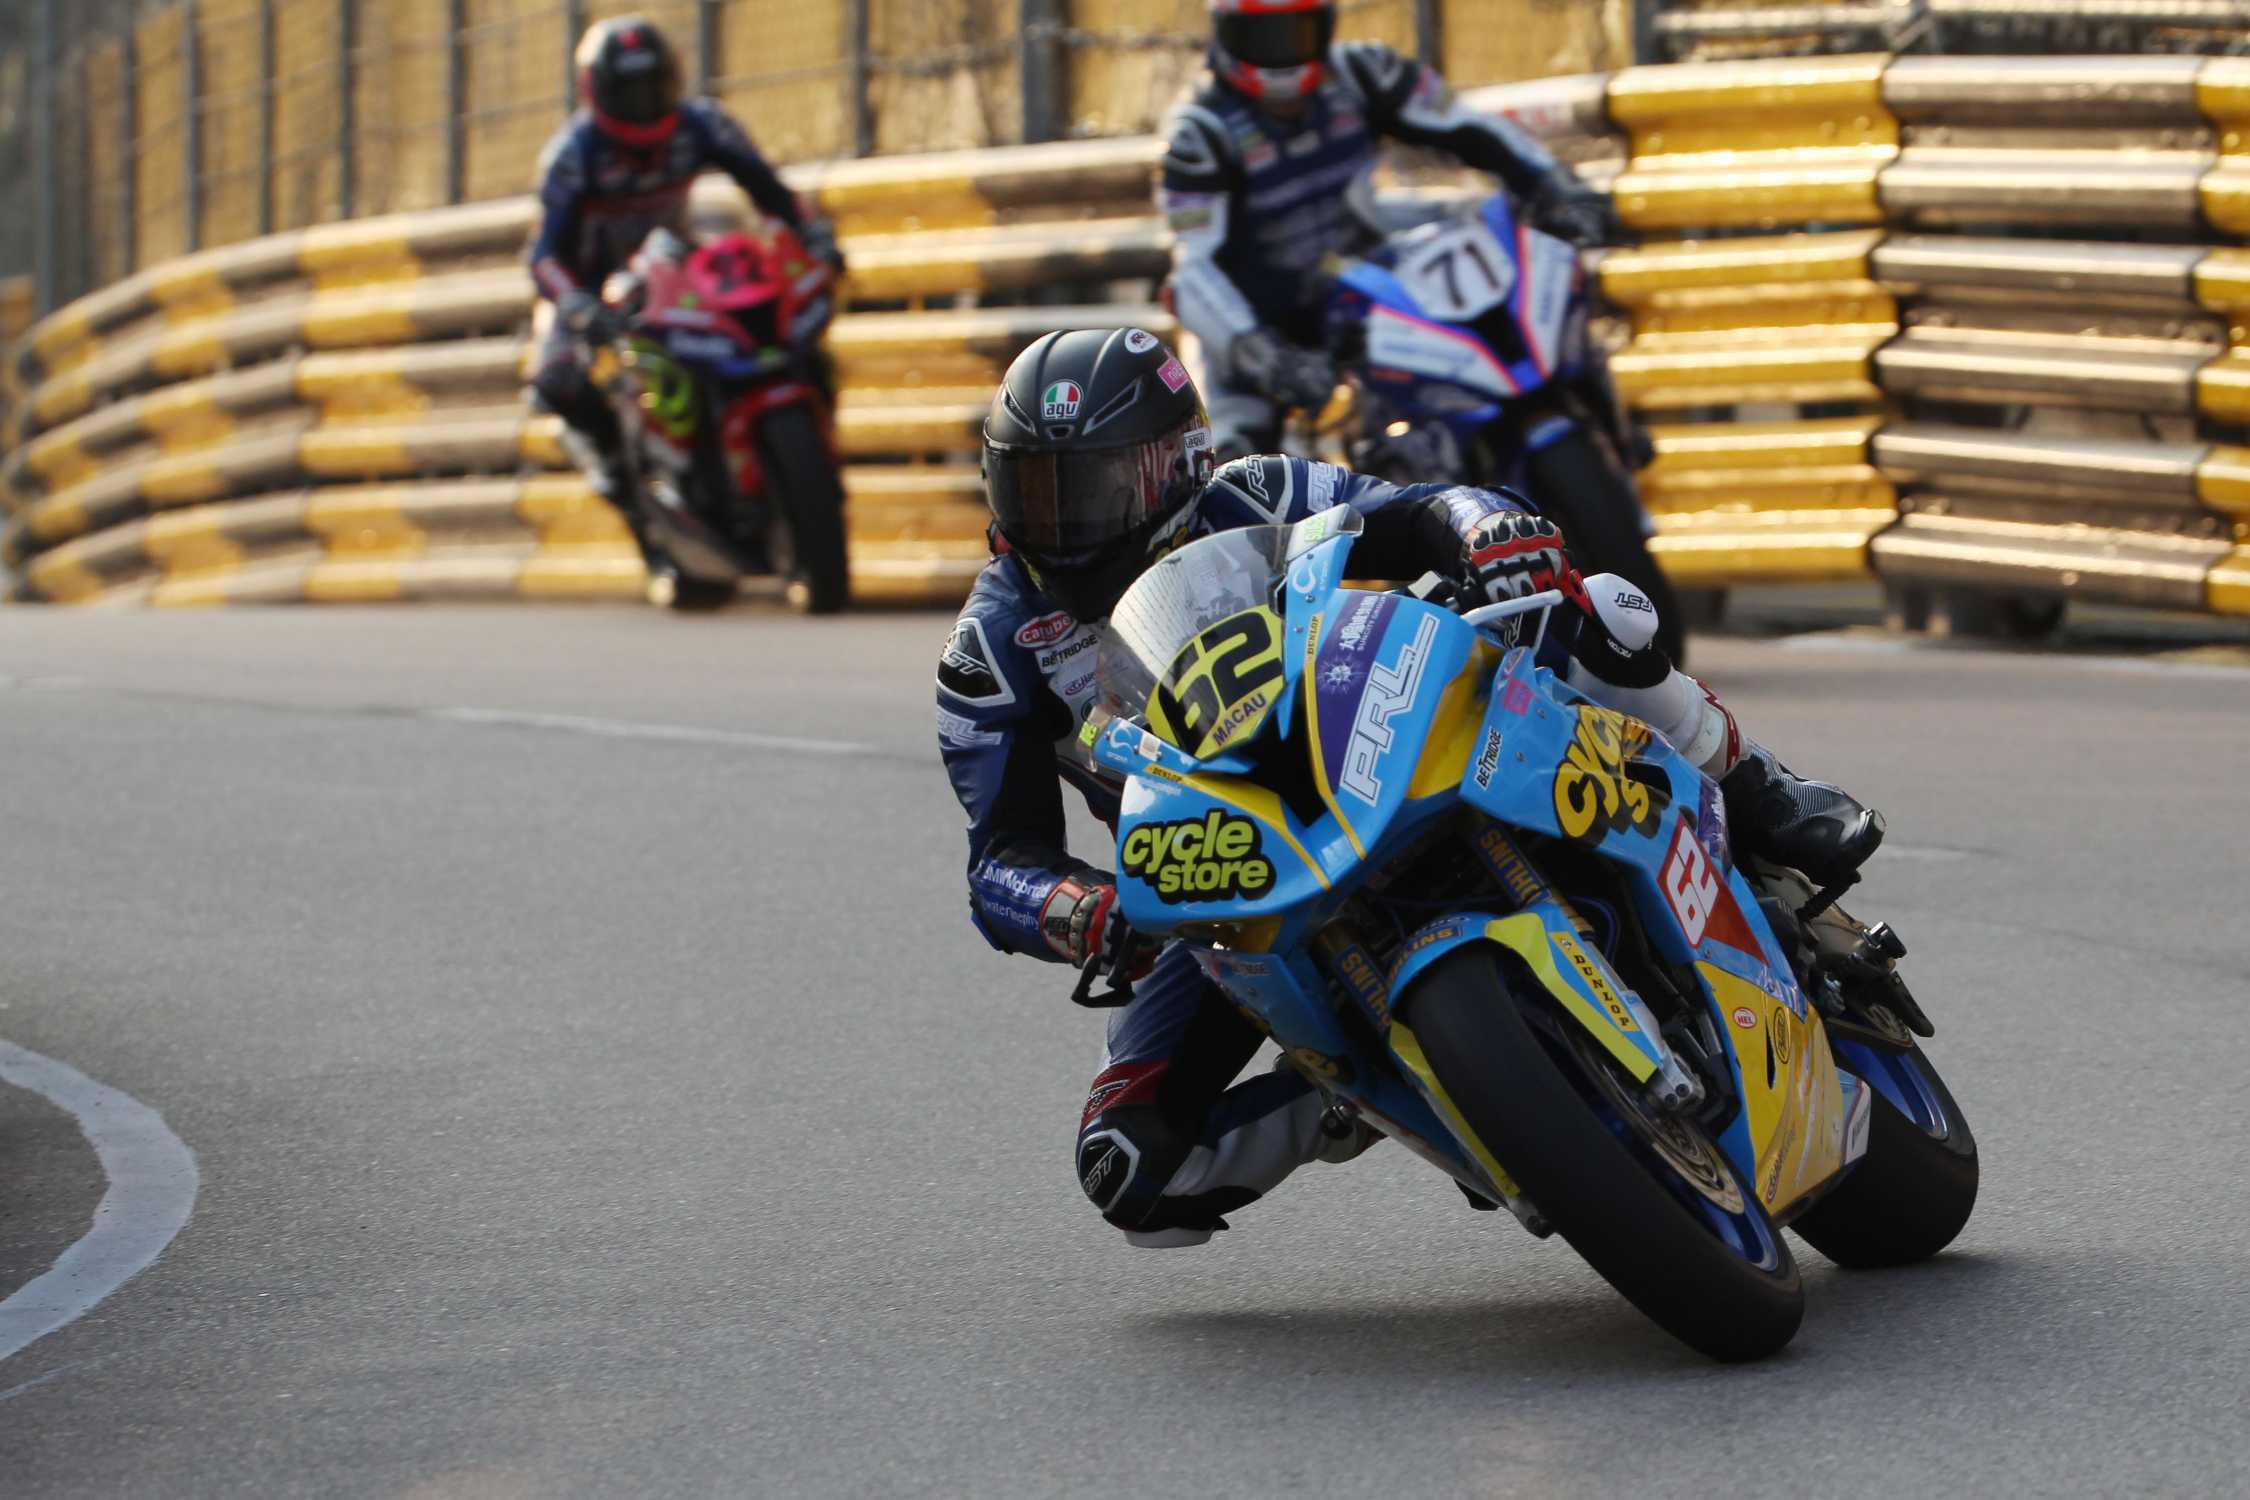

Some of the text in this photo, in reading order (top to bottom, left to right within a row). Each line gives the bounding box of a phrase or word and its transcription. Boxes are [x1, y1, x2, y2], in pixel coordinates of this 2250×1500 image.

[1421, 239, 1500, 311] 71
[1307, 615, 1319, 655] DUNLOP
[1158, 612, 1283, 757] 62
[1341, 613, 1439, 806] PRL
[1212, 693, 1267, 747] MACAU
[1123, 811, 1254, 874] cycle
[1158, 857, 1269, 893] store
[1573, 954, 1629, 1027] DUNLOP
